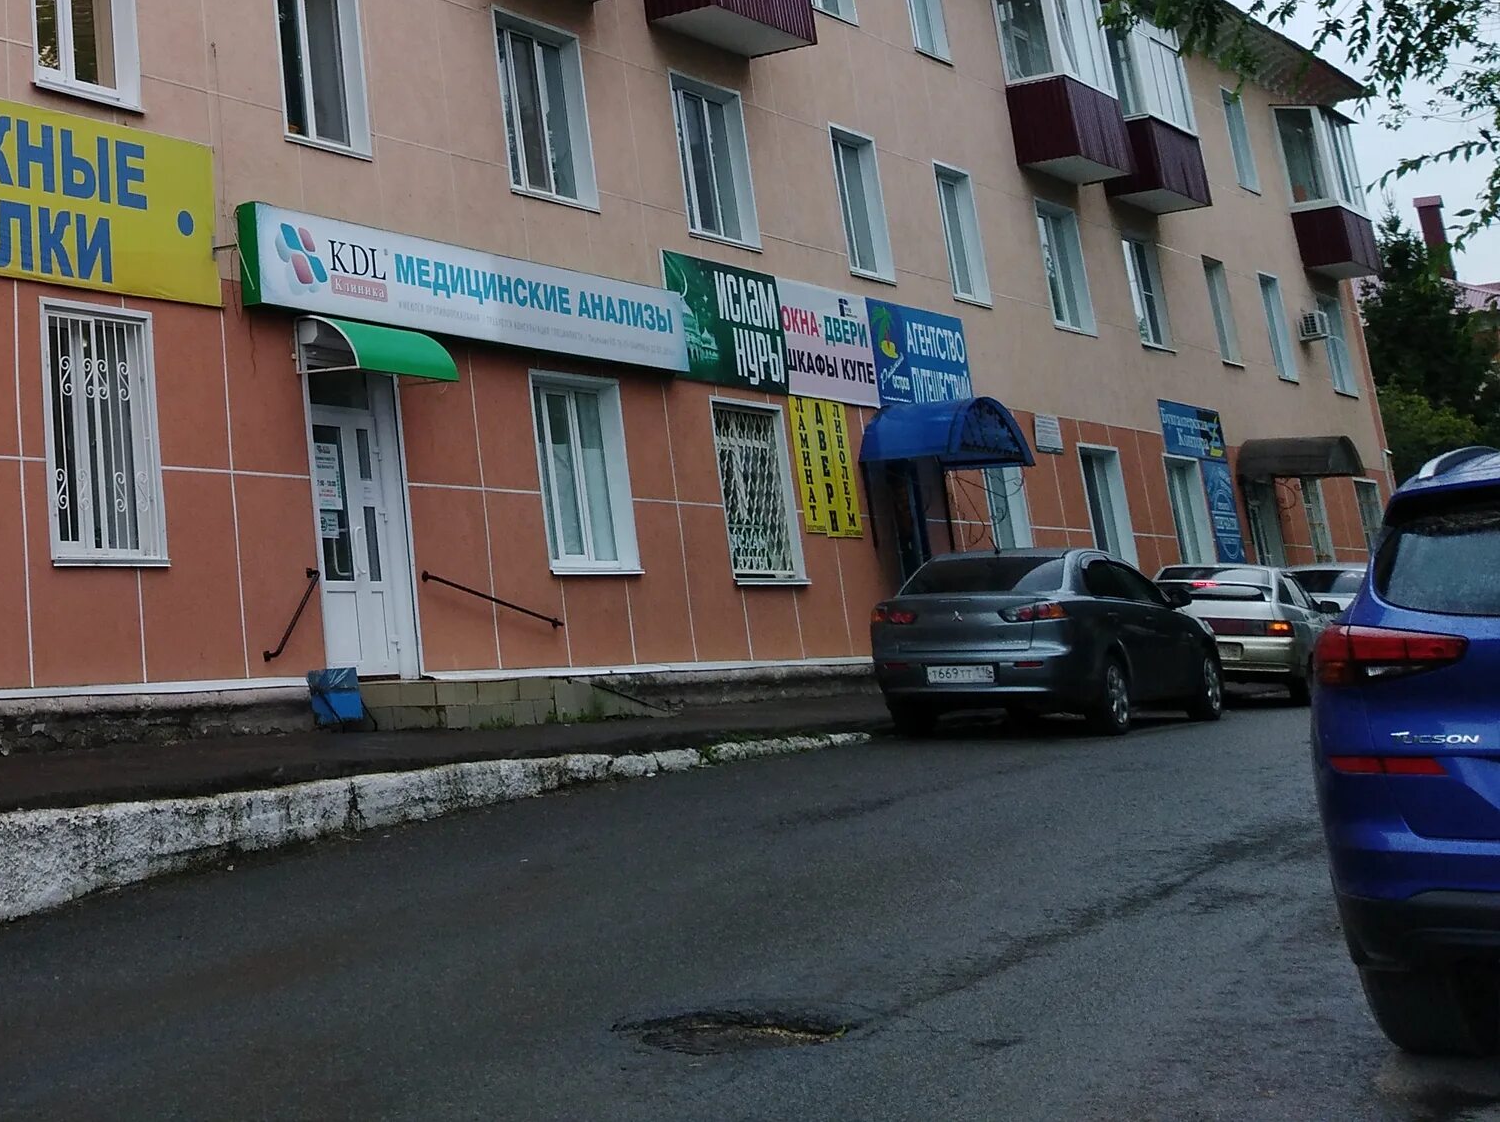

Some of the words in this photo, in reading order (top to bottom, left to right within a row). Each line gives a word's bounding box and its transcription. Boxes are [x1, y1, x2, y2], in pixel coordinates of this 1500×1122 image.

[328, 239, 387, 281] KDL
[335, 278, 385, 298] Клиника
[394, 253, 572, 316] МЕДИЦИНСКИЕ
[578, 290, 674, 334] АНАЛИЗЫ
[780, 305, 820, 337] ОКНА
[823, 316, 869, 348] ДВЕРИ
[906, 321, 966, 364] АГЕНТСТВО
[788, 348, 839, 378] ШКАФЫ
[840, 358, 876, 385] КУПЕ
[795, 397, 817, 521] ЛАМИНАТ
[832, 404, 857, 528] ЛИНОЛЕУМ
[1390, 731, 1480, 744] TUCSON
